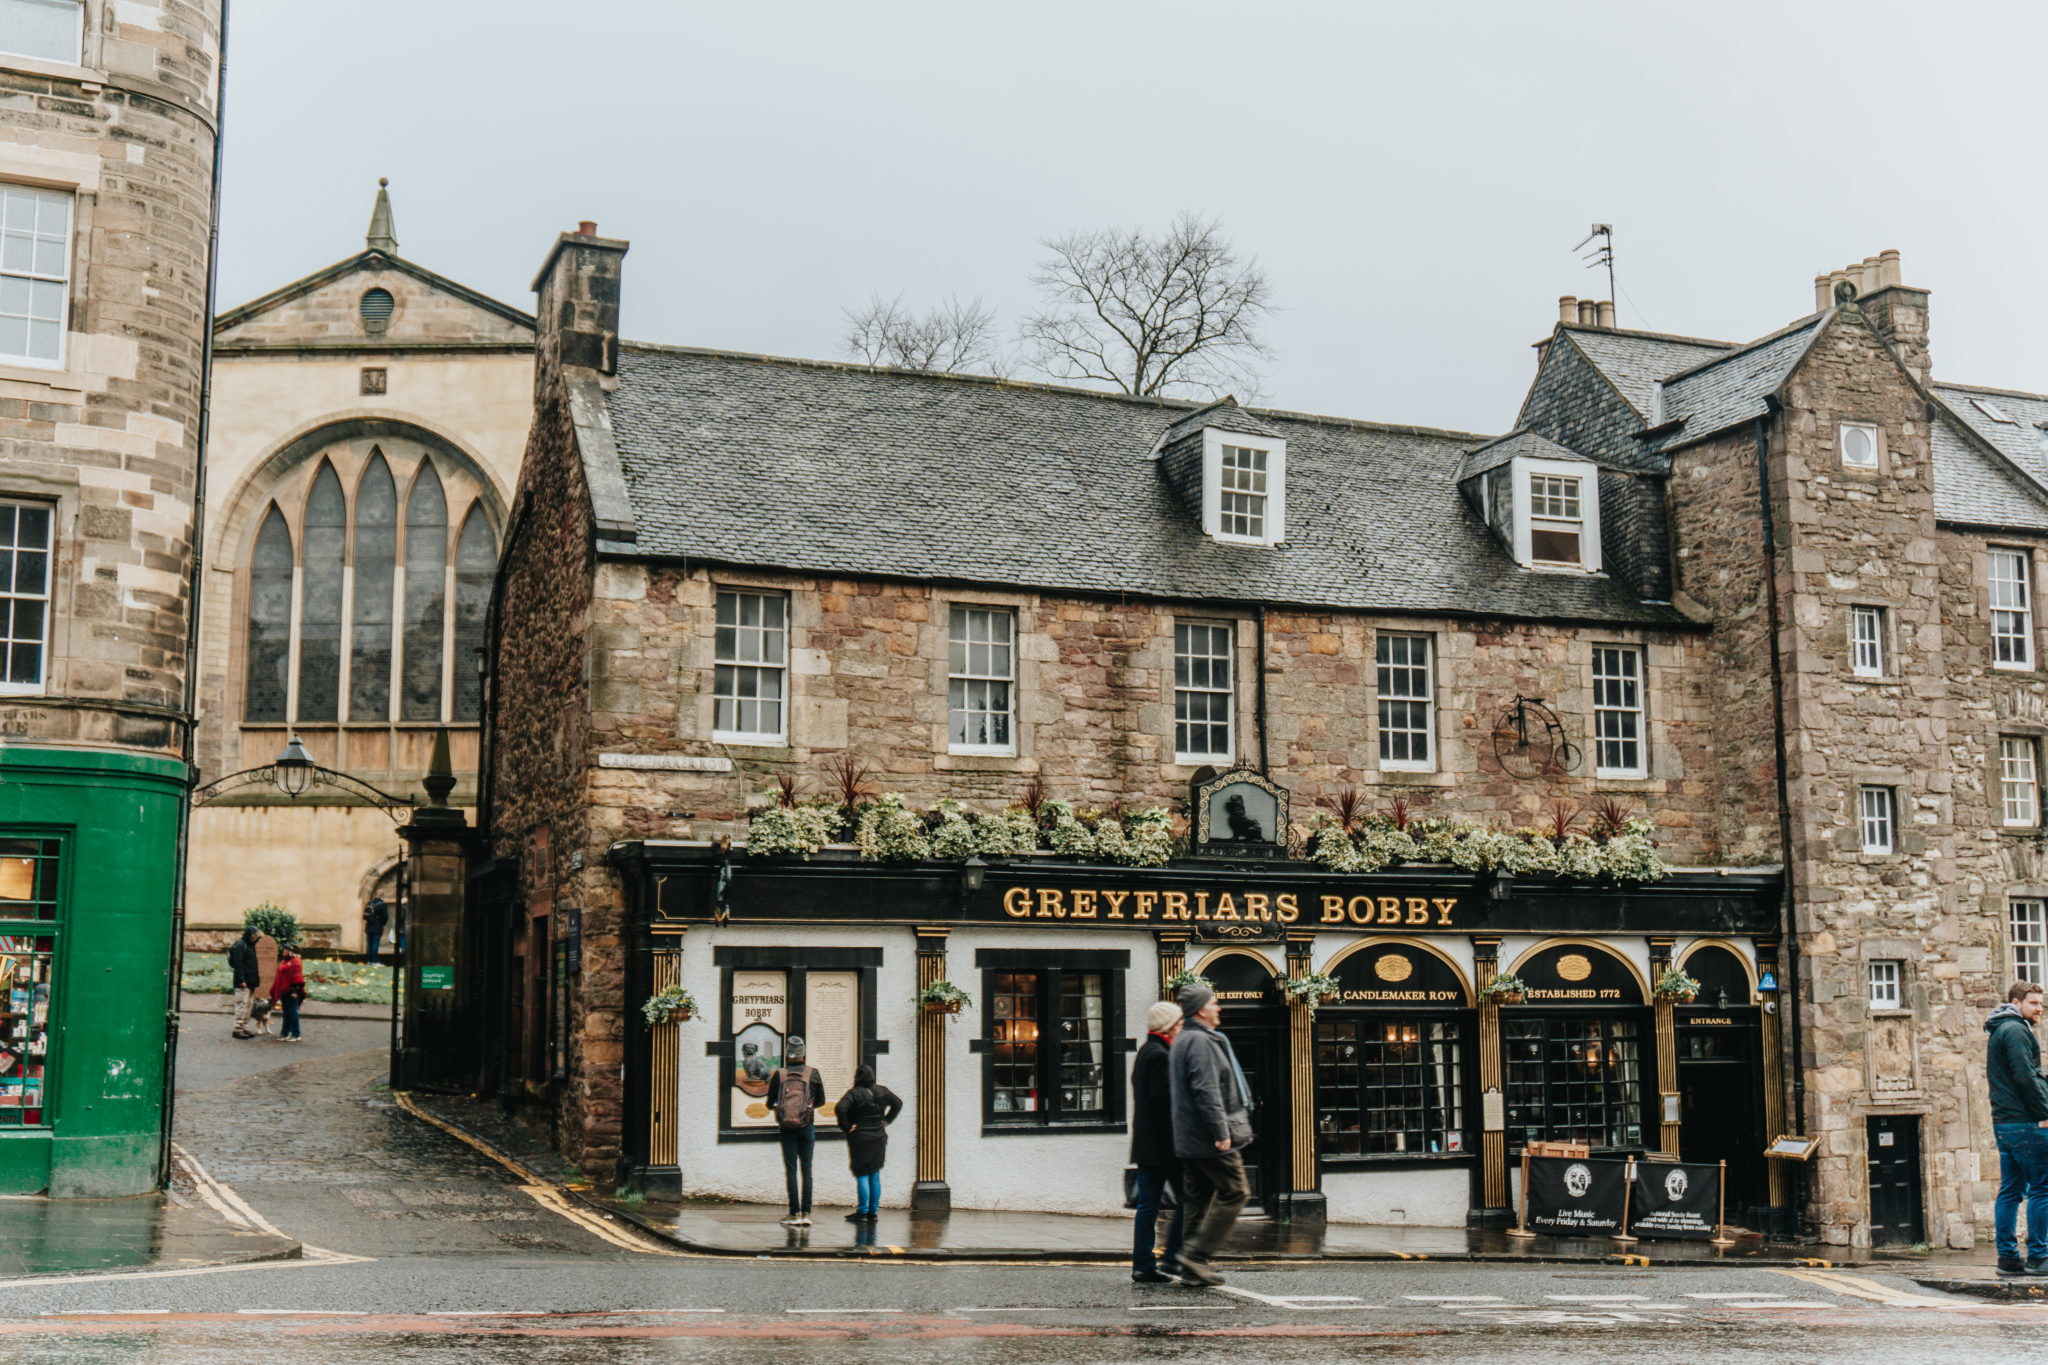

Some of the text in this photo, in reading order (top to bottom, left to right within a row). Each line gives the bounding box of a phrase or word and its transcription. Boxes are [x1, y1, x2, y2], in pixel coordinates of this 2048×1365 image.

[1003, 886, 1458, 926] GREYFRIARS BOBBY
[1344, 990, 1424, 1000] CANDLEMAKER
[1429, 991, 1458, 1000] ROW
[1527, 989, 1620, 998] ESTABLISHED 1772
[732, 996, 784, 1004] GREYFRIARS
[745, 1008, 772, 1017] BOBBY
[1558, 1210, 1596, 1218] Live Music
[1536, 1216, 1554, 1226] Every
[1556, 1218, 1578, 1227] Friday
[1586, 1219, 1616, 1228] Saturday
